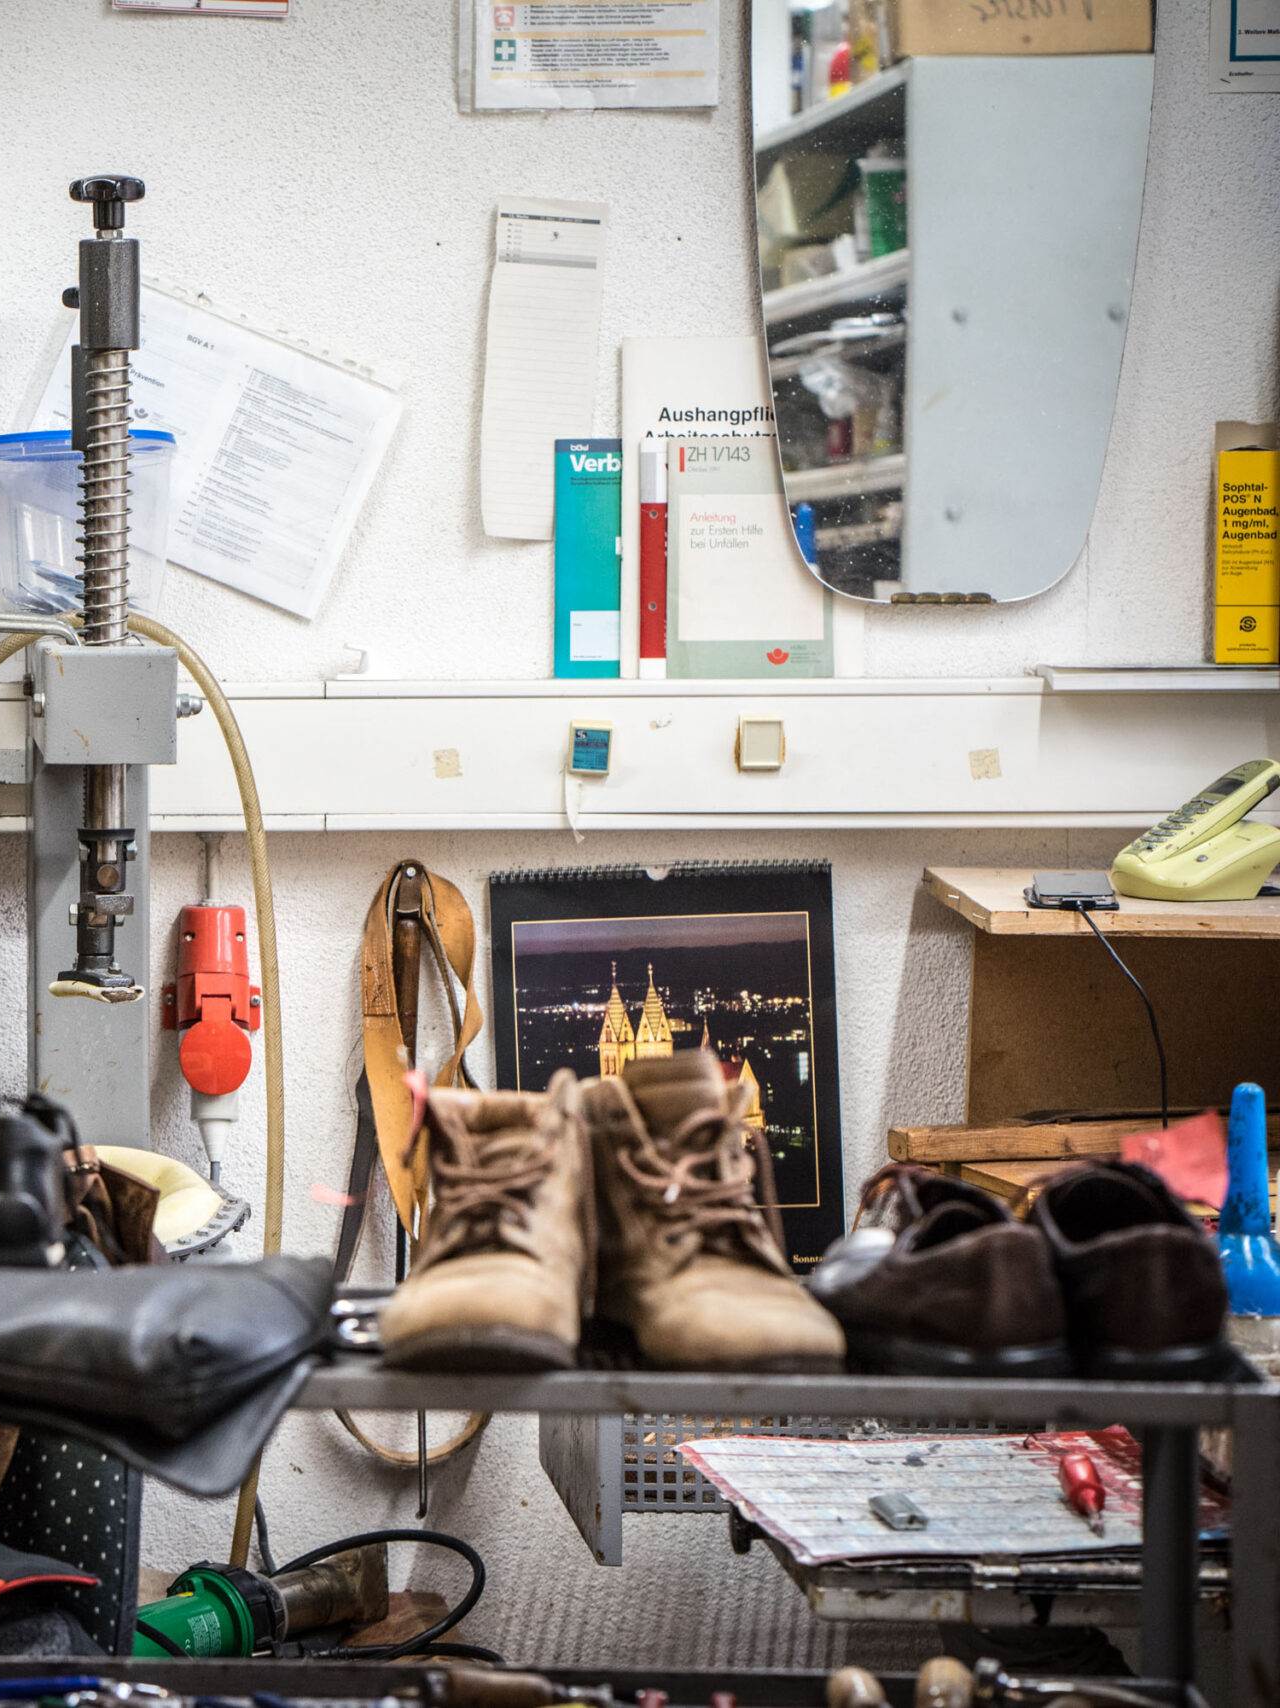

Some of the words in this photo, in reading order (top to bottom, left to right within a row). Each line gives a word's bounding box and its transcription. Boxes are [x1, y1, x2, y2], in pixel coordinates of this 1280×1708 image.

[687, 446, 707, 462] ZH
[711, 446, 751, 462] 1/143
[570, 453, 621, 472] Verb
[1223, 482, 1269, 494] Sophtal-
[1253, 494, 1262, 503] N
[1222, 506, 1279, 517] Augenbad,
[690, 512, 736, 525] Anleitung
[1223, 519, 1228, 528] 1
[1232, 519, 1270, 529] mg/ml,
[708, 525, 738, 535] Ersten
[742, 524, 763, 535] Hilfe
[1222, 530, 1277, 541] Augenbad
[690, 537, 706, 549] bei
[709, 537, 749, 549] Unfällen
[793, 1254, 826, 1263] Sonnta
